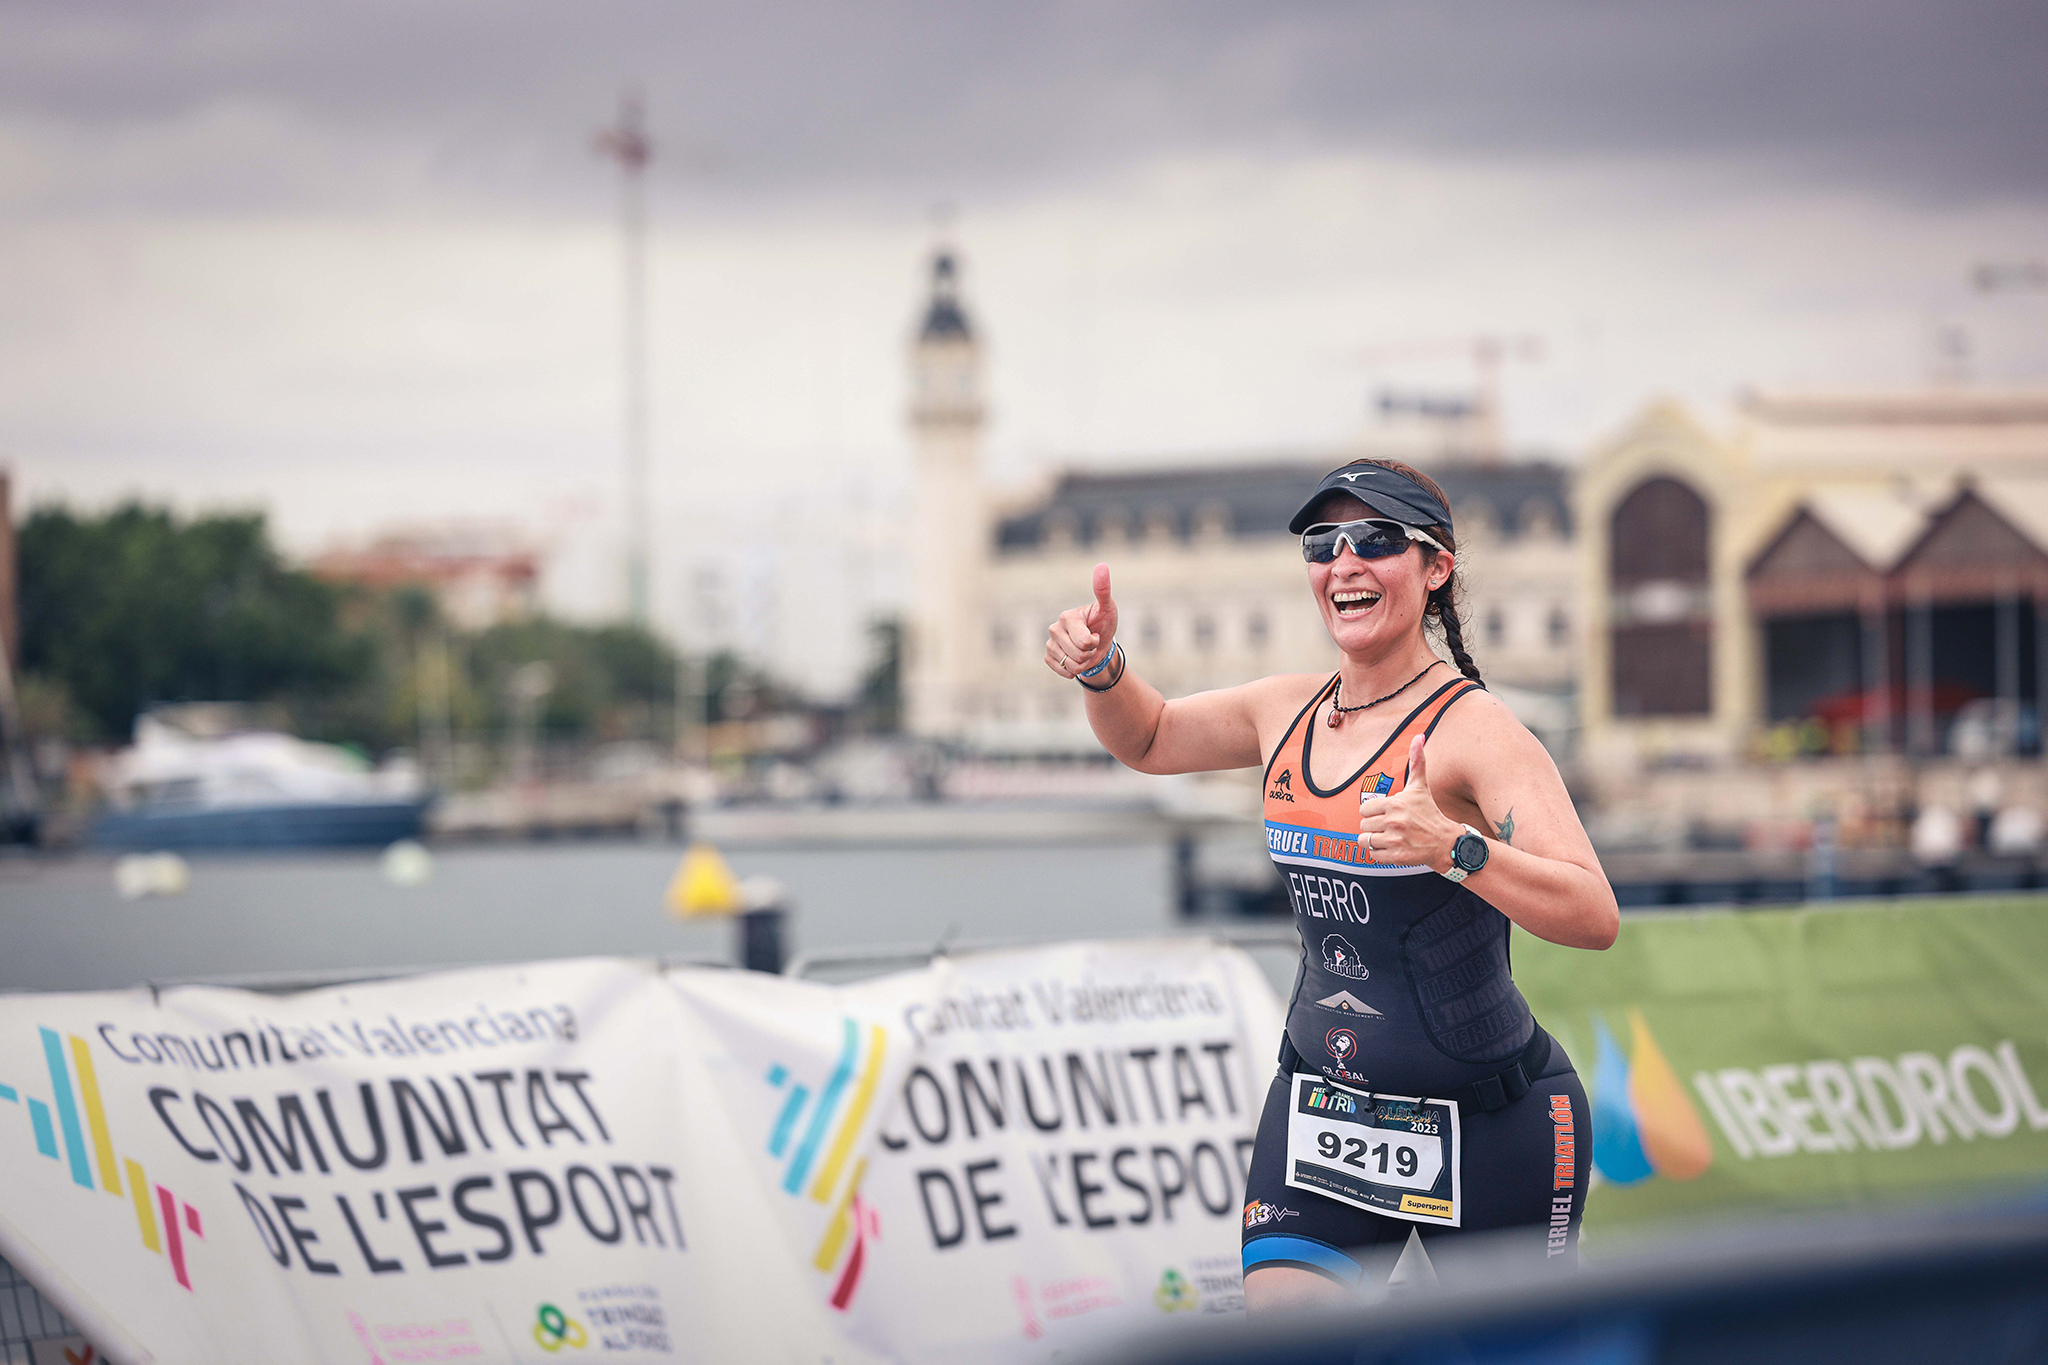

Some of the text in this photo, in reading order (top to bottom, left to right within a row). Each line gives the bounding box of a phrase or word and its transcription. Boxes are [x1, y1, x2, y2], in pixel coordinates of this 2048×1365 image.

[1265, 826, 1383, 865] TERUEL TRIATLO
[1288, 872, 1370, 925] FIERRO
[97, 1004, 579, 1072] Comunitat Valenciana
[146, 1068, 613, 1177] COMUNITAT
[1410, 1121, 1439, 1134] 2023
[1317, 1131, 1418, 1177] 9219
[1547, 1094, 1575, 1259] TERUEL TRIATLÓN
[231, 1164, 687, 1275] DE L'ESPORT
[917, 1159, 1018, 1249] DE
[1407, 1200, 1449, 1212] Supersprint
